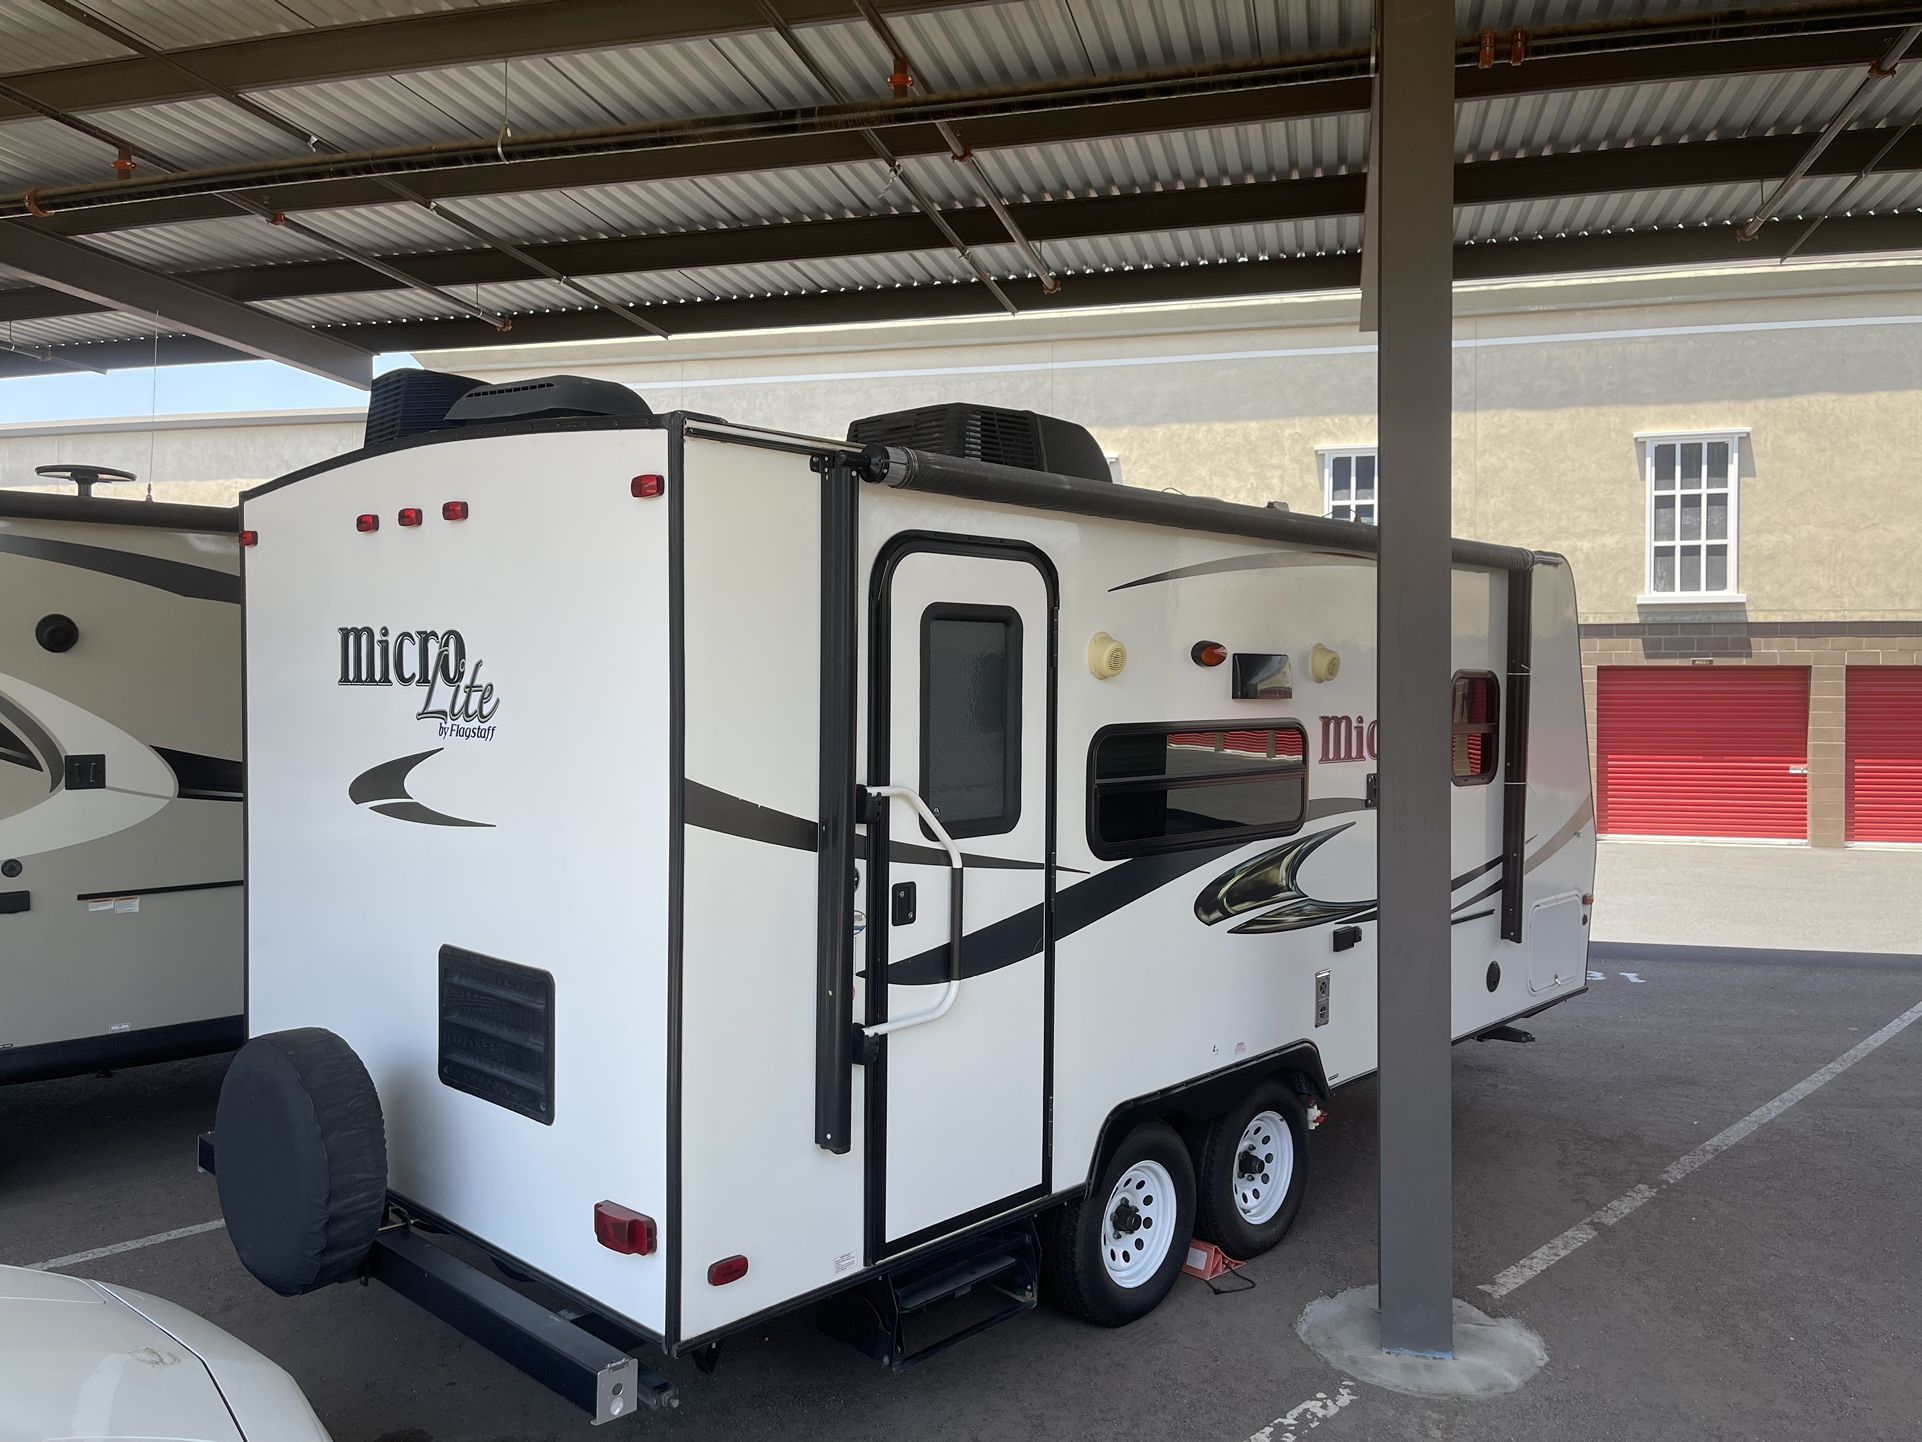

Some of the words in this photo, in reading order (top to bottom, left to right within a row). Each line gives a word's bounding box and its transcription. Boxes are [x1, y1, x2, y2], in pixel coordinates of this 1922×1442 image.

[338, 626, 466, 686] micro
[416, 646, 500, 724] Lite
[438, 723, 449, 740] by
[449, 724, 496, 741] Flagstaff
